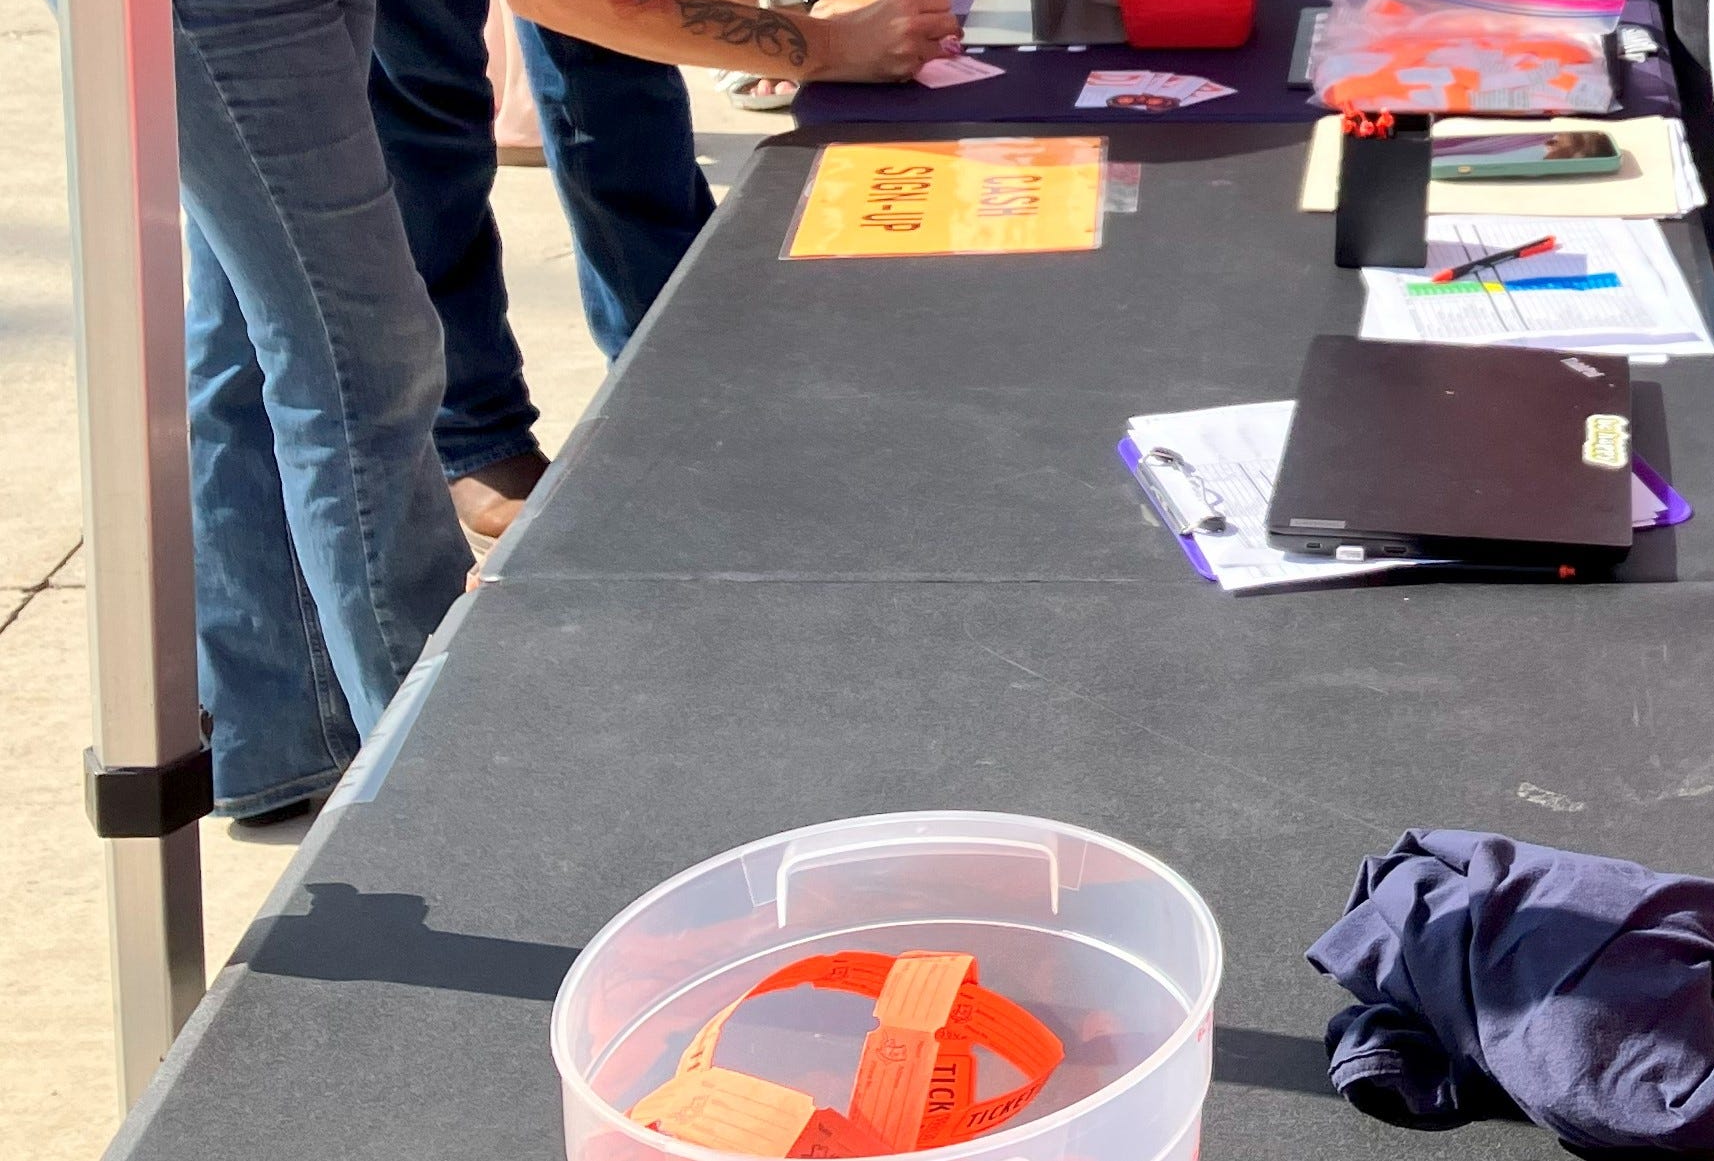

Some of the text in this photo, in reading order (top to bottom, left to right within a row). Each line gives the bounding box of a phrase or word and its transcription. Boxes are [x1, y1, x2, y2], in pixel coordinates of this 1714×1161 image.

[859, 165, 936, 233] SIGN-UP
[975, 173, 1043, 219] CASH
[928, 1062, 957, 1113] TICK
[966, 1086, 1036, 1128] TICKET
